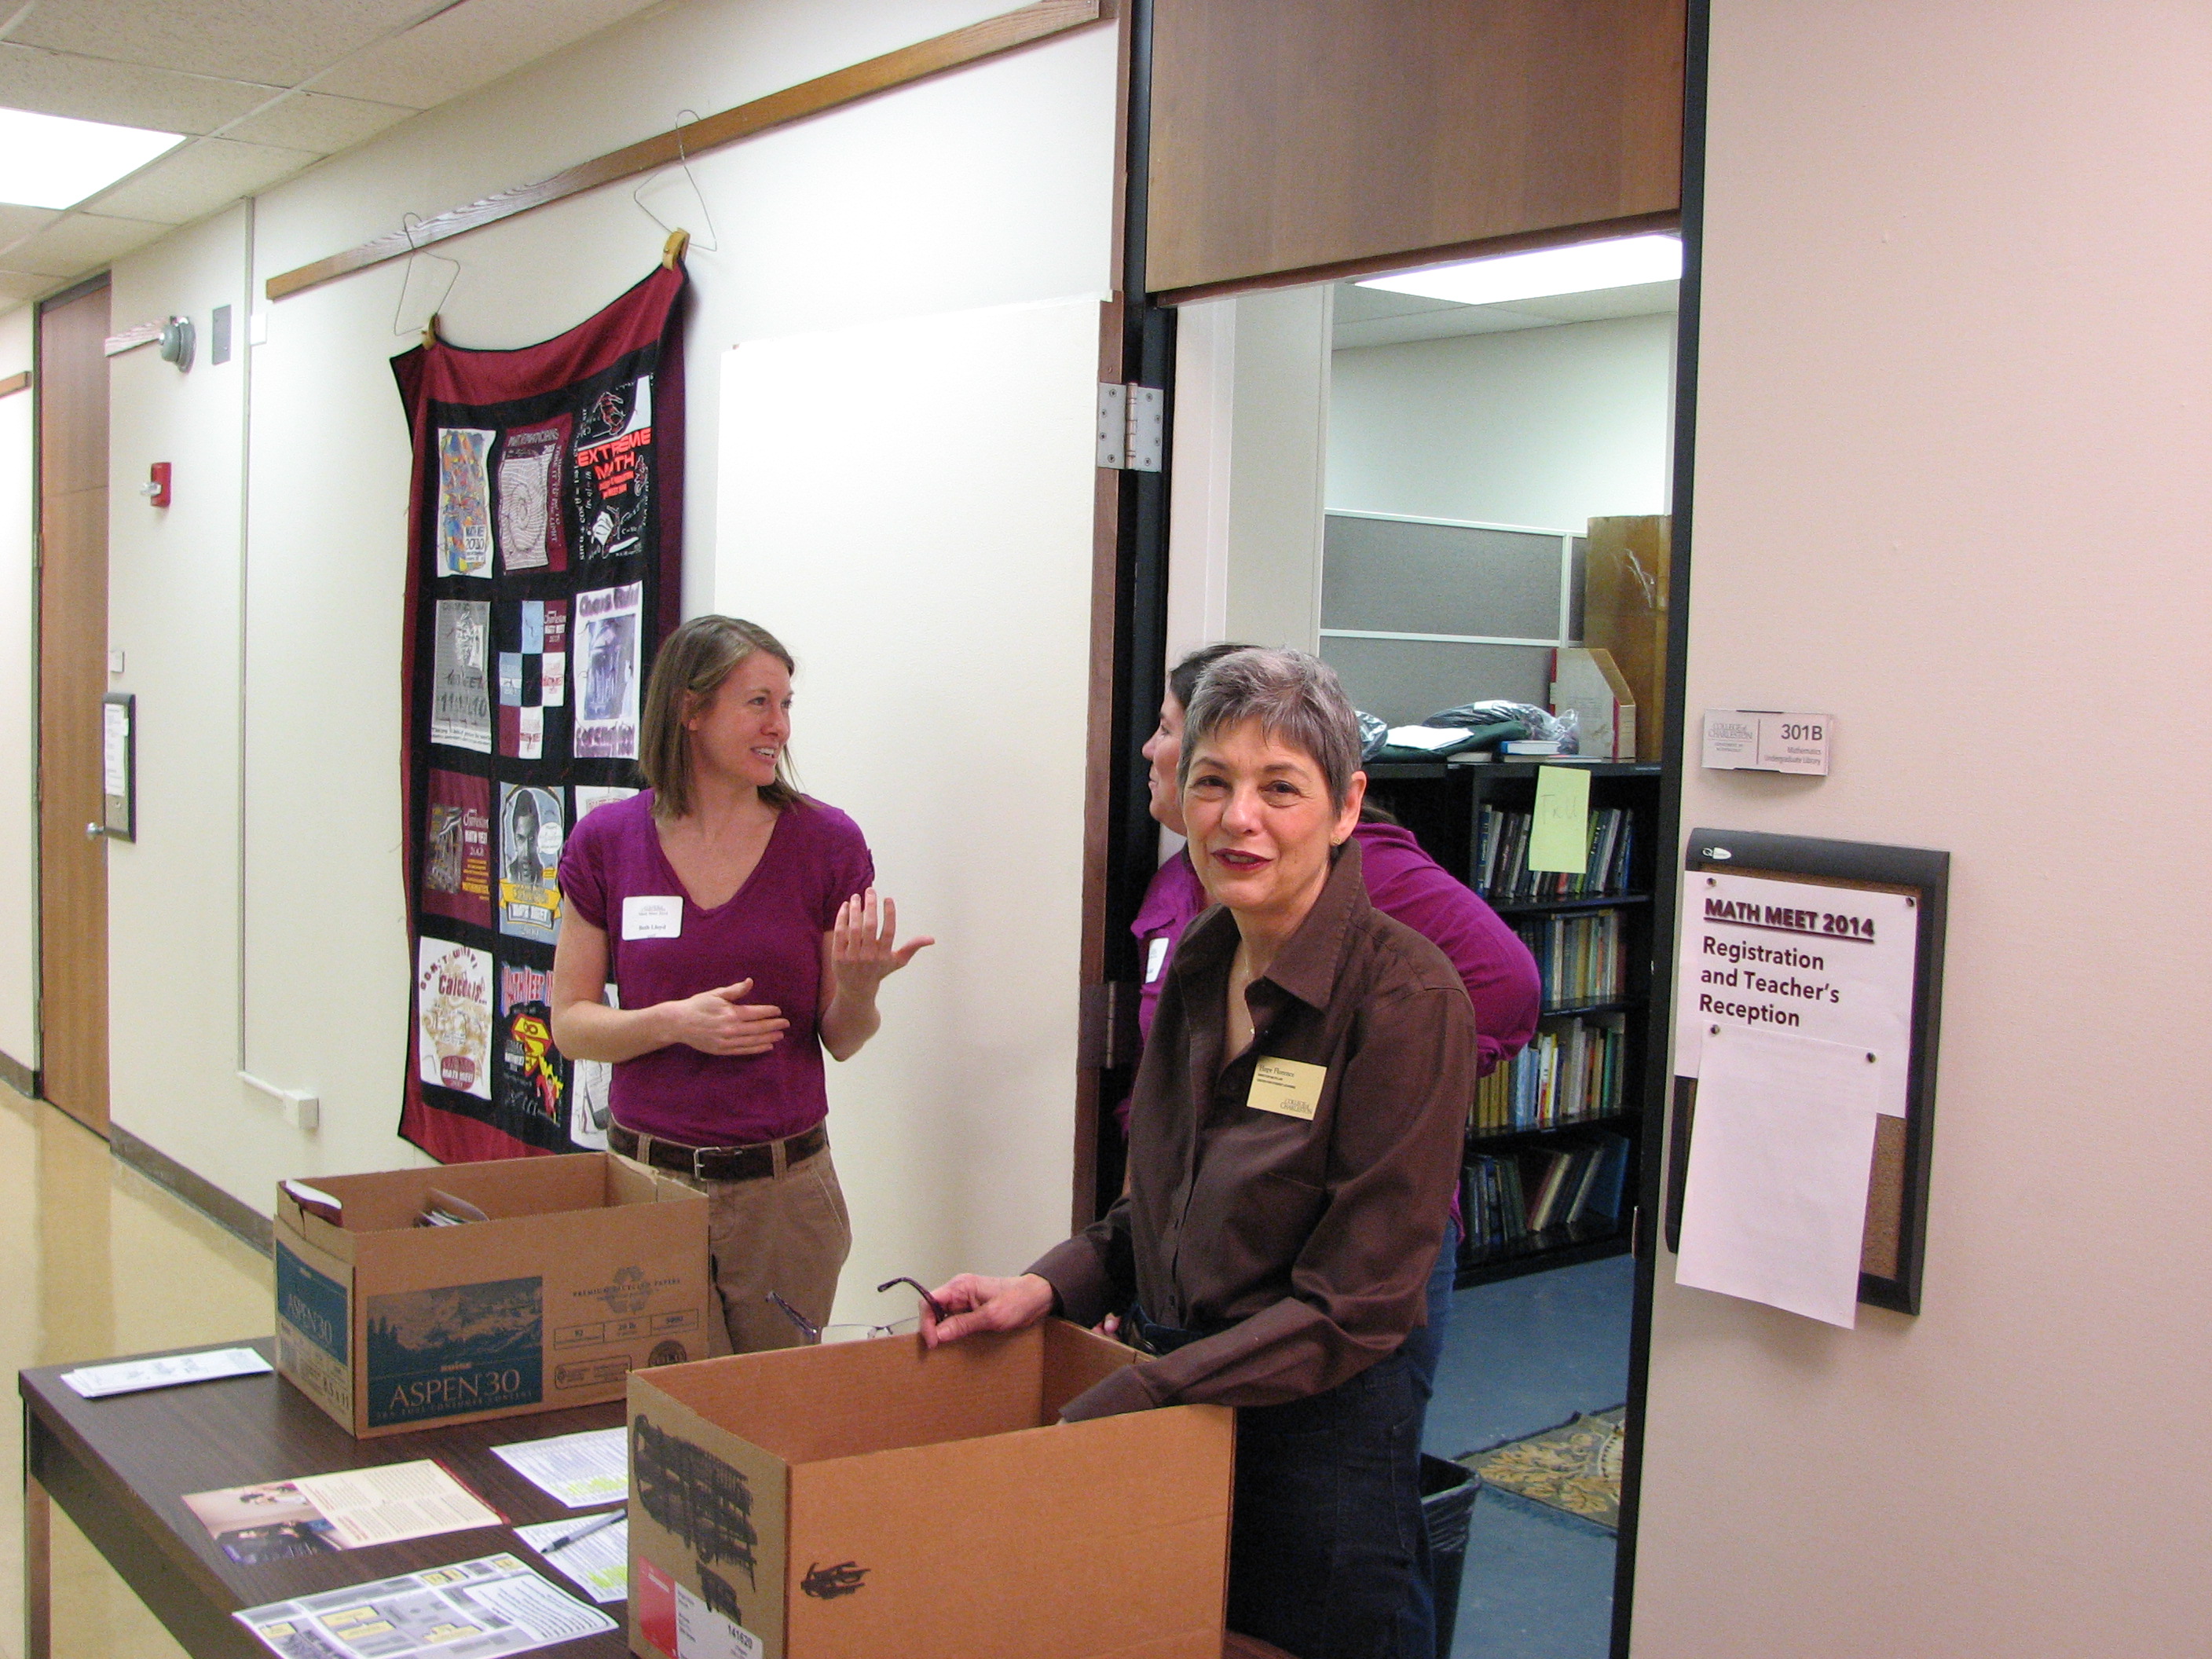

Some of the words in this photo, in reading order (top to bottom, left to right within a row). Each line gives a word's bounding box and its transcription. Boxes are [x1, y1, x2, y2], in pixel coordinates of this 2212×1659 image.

[577, 427, 652, 467] EXTREME
[1781, 723, 1822, 741] 301B
[1787, 747, 1822, 756] Mathematics
[1705, 898, 1760, 922] MATH
[1765, 906, 1818, 929] MEET
[1822, 913, 1874, 937] 2014
[1703, 936, 1824, 970] Registration
[1701, 968, 1738, 987] and
[1743, 971, 1840, 1003] Teacher's
[1699, 993, 1800, 1027] Reception
[390, 1374, 478, 1410] ASPEN
[484, 1368, 520, 1396] 30
